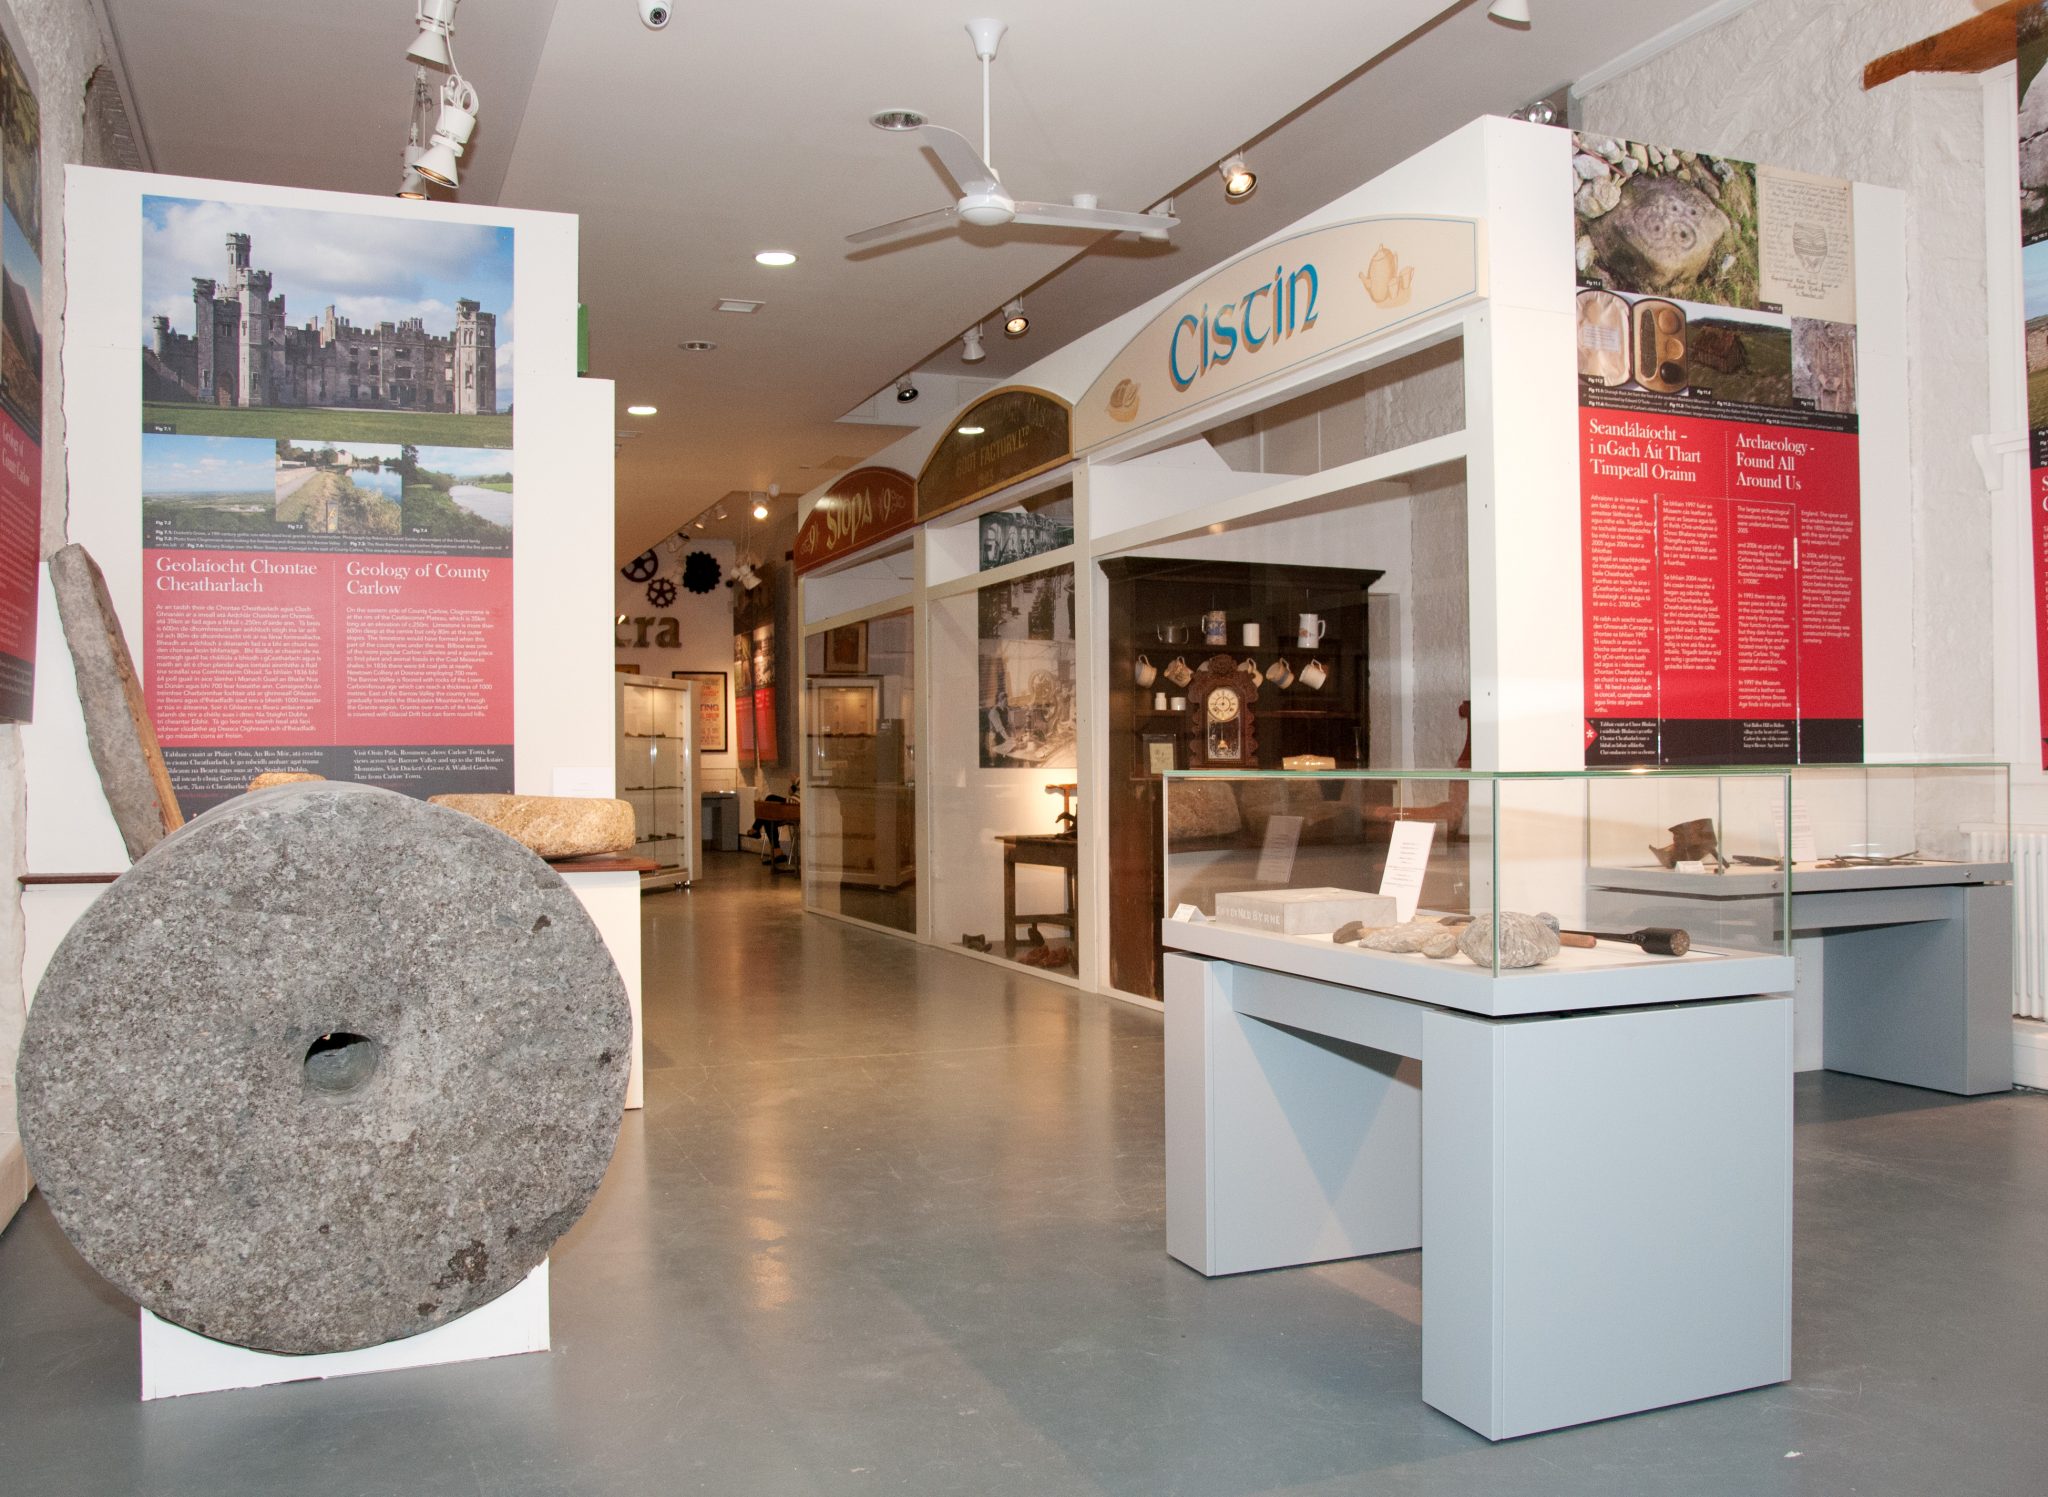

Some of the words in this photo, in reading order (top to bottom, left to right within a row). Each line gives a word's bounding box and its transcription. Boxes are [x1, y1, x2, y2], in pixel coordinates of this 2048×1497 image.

[1590, 438, 1594, 454] i
[1598, 440, 1640, 457] nGach
[1644, 440, 1663, 459] Áit
[1665, 445, 1701, 463] Thart
[1736, 433, 1808, 456] Archaeology
[1736, 452, 1774, 469] Found
[1778, 456, 1795, 471] All
[1652, 463, 1696, 482] Orainn
[1736, 471, 1782, 489] Around
[1785, 476, 1802, 491] Us
[156, 557, 245, 573] Geolaíocht
[250, 559, 317, 575] Chontae
[347, 562, 410, 579] Geology
[415, 563, 431, 576] of
[435, 564, 490, 582] County
[156, 576, 263, 592] Cheatharlach
[347, 580, 402, 595] Carlow
